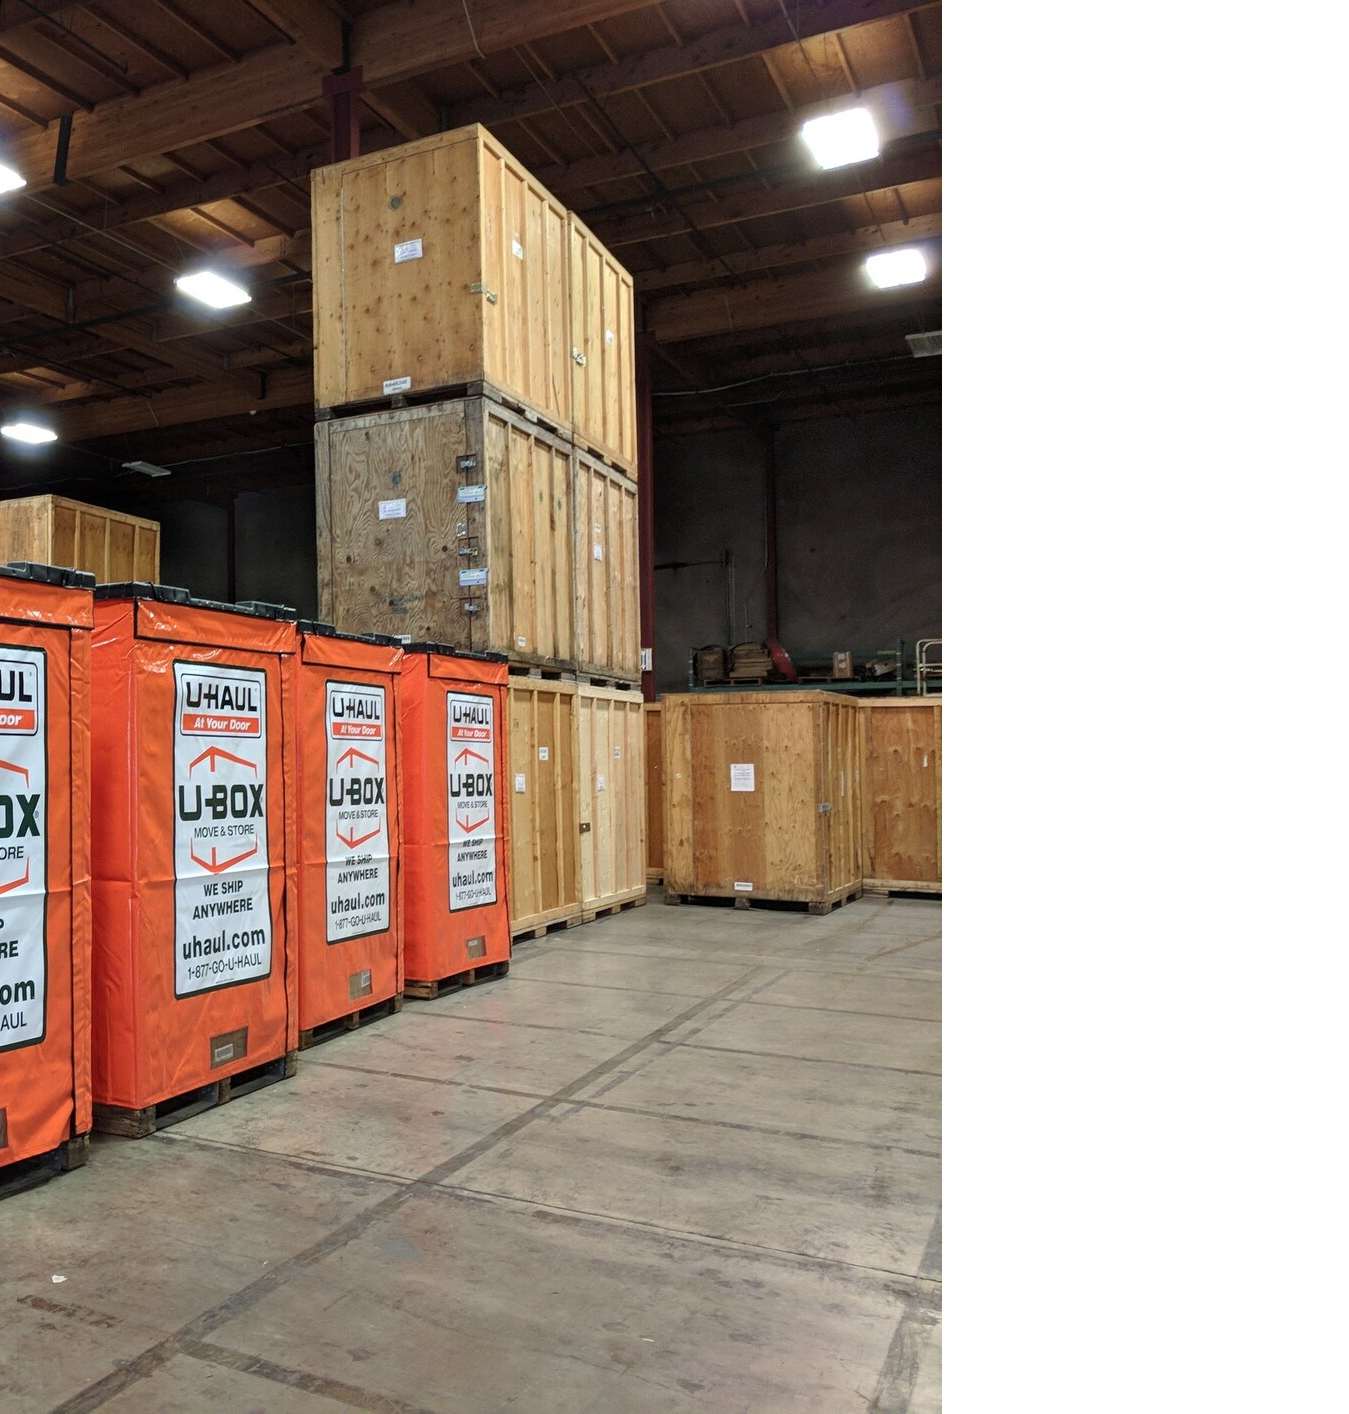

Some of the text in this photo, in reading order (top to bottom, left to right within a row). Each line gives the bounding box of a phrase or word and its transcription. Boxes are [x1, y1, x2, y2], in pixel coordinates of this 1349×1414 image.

[186, 681, 258, 712] U-HAUL
[332, 697, 380, 720] U-HAUL
[453, 705, 489, 725] U-HAUL
[194, 717, 251, 730] At Your Door
[348, 725, 361, 734] Your
[361, 726, 376, 735] Door
[329, 777, 385, 806] U-BOX
[450, 774, 493, 797] U-BOX
[178, 784, 264, 821] U-BOX
[339, 810, 355, 820] MOVE
[360, 809, 378, 819] STORE
[194, 824, 254, 839] MOVE & STORE
[345, 855, 355, 866] WE
[457, 850, 487, 862] ANYWHERE
[338, 868, 378, 883] ANYWHERE
[452, 870, 493, 888] uhaul.com
[203, 880, 243, 897] WE SHIP
[193, 898, 253, 920] ANYWHERE
[331, 892, 385, 914] uhaul.com
[182, 928, 265, 960] uhaul.com
[187, 953, 262, 980] 1-877-GO-U-HAUL
